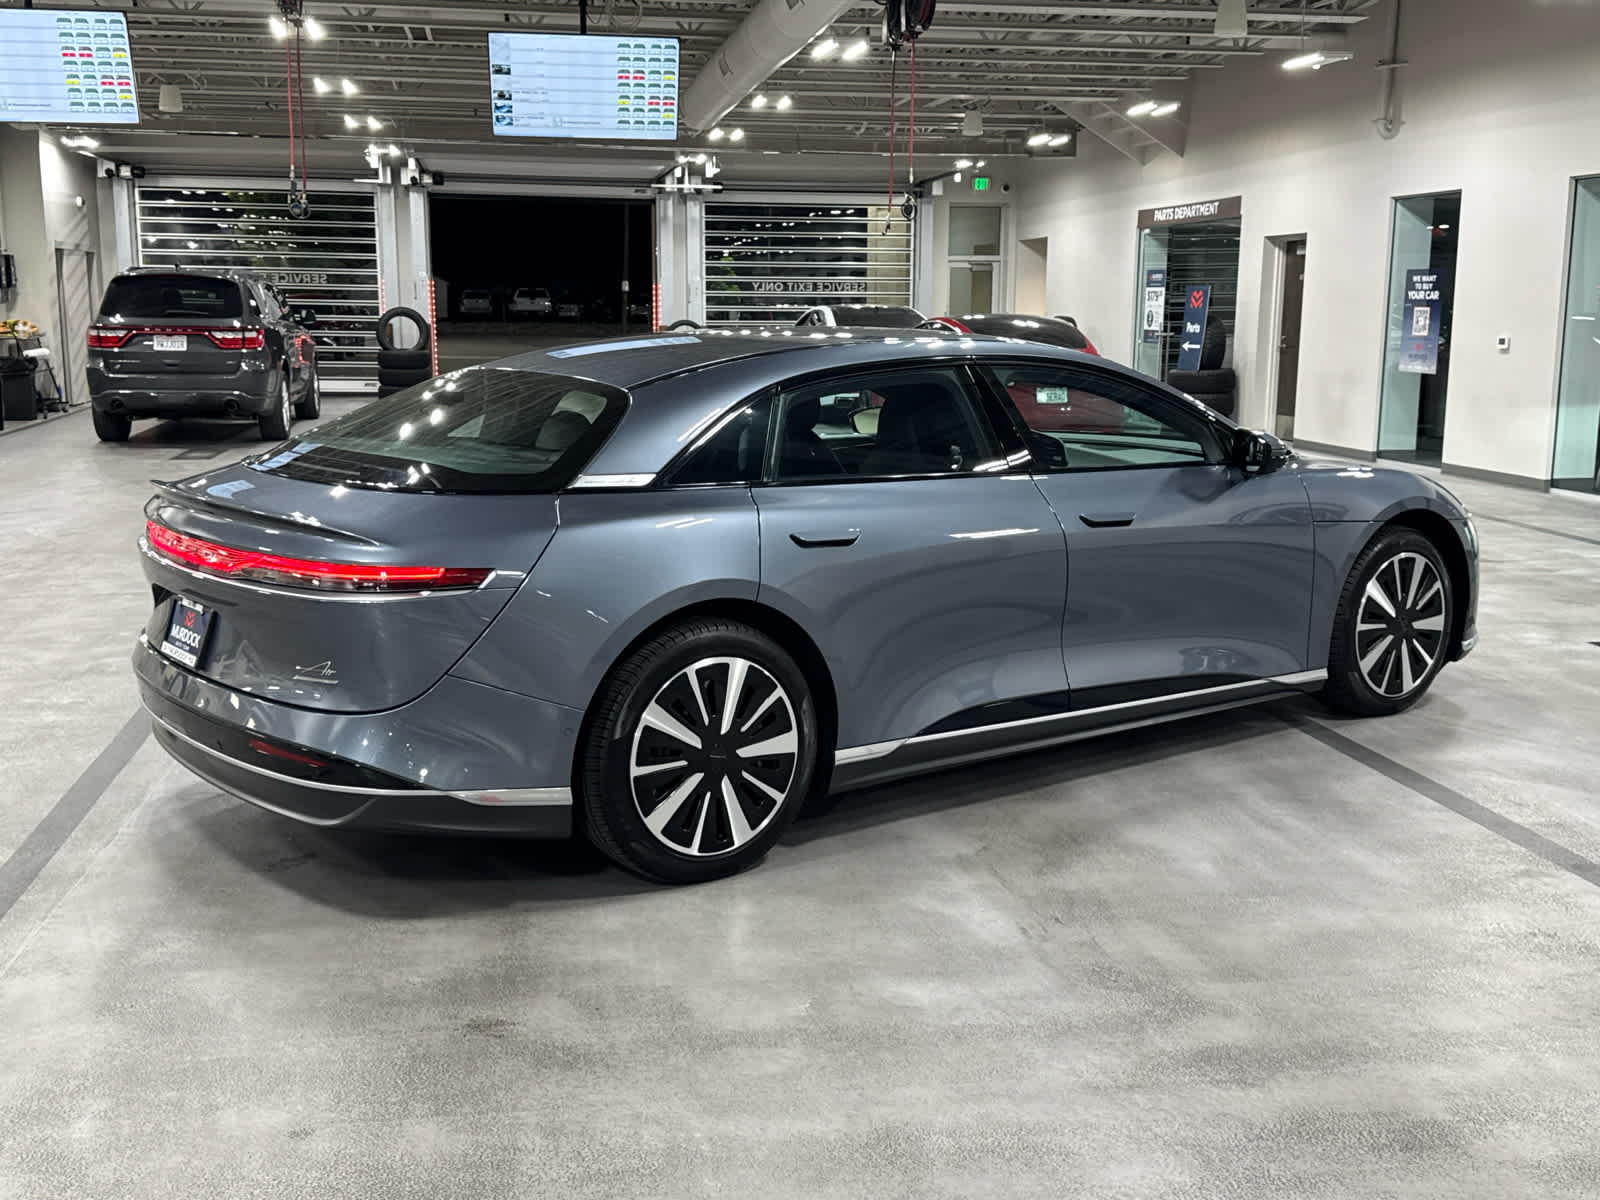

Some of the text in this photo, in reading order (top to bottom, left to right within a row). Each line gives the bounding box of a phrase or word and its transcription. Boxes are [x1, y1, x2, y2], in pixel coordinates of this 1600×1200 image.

[1153, 202, 1219, 221] PARTS DEPARTMENT
[1412, 274, 1438, 283] WE WANT
[1407, 290, 1440, 300] YOUR CAR
[1186, 321, 1201, 333] Parts
[170, 624, 201, 648] MURDOCK
